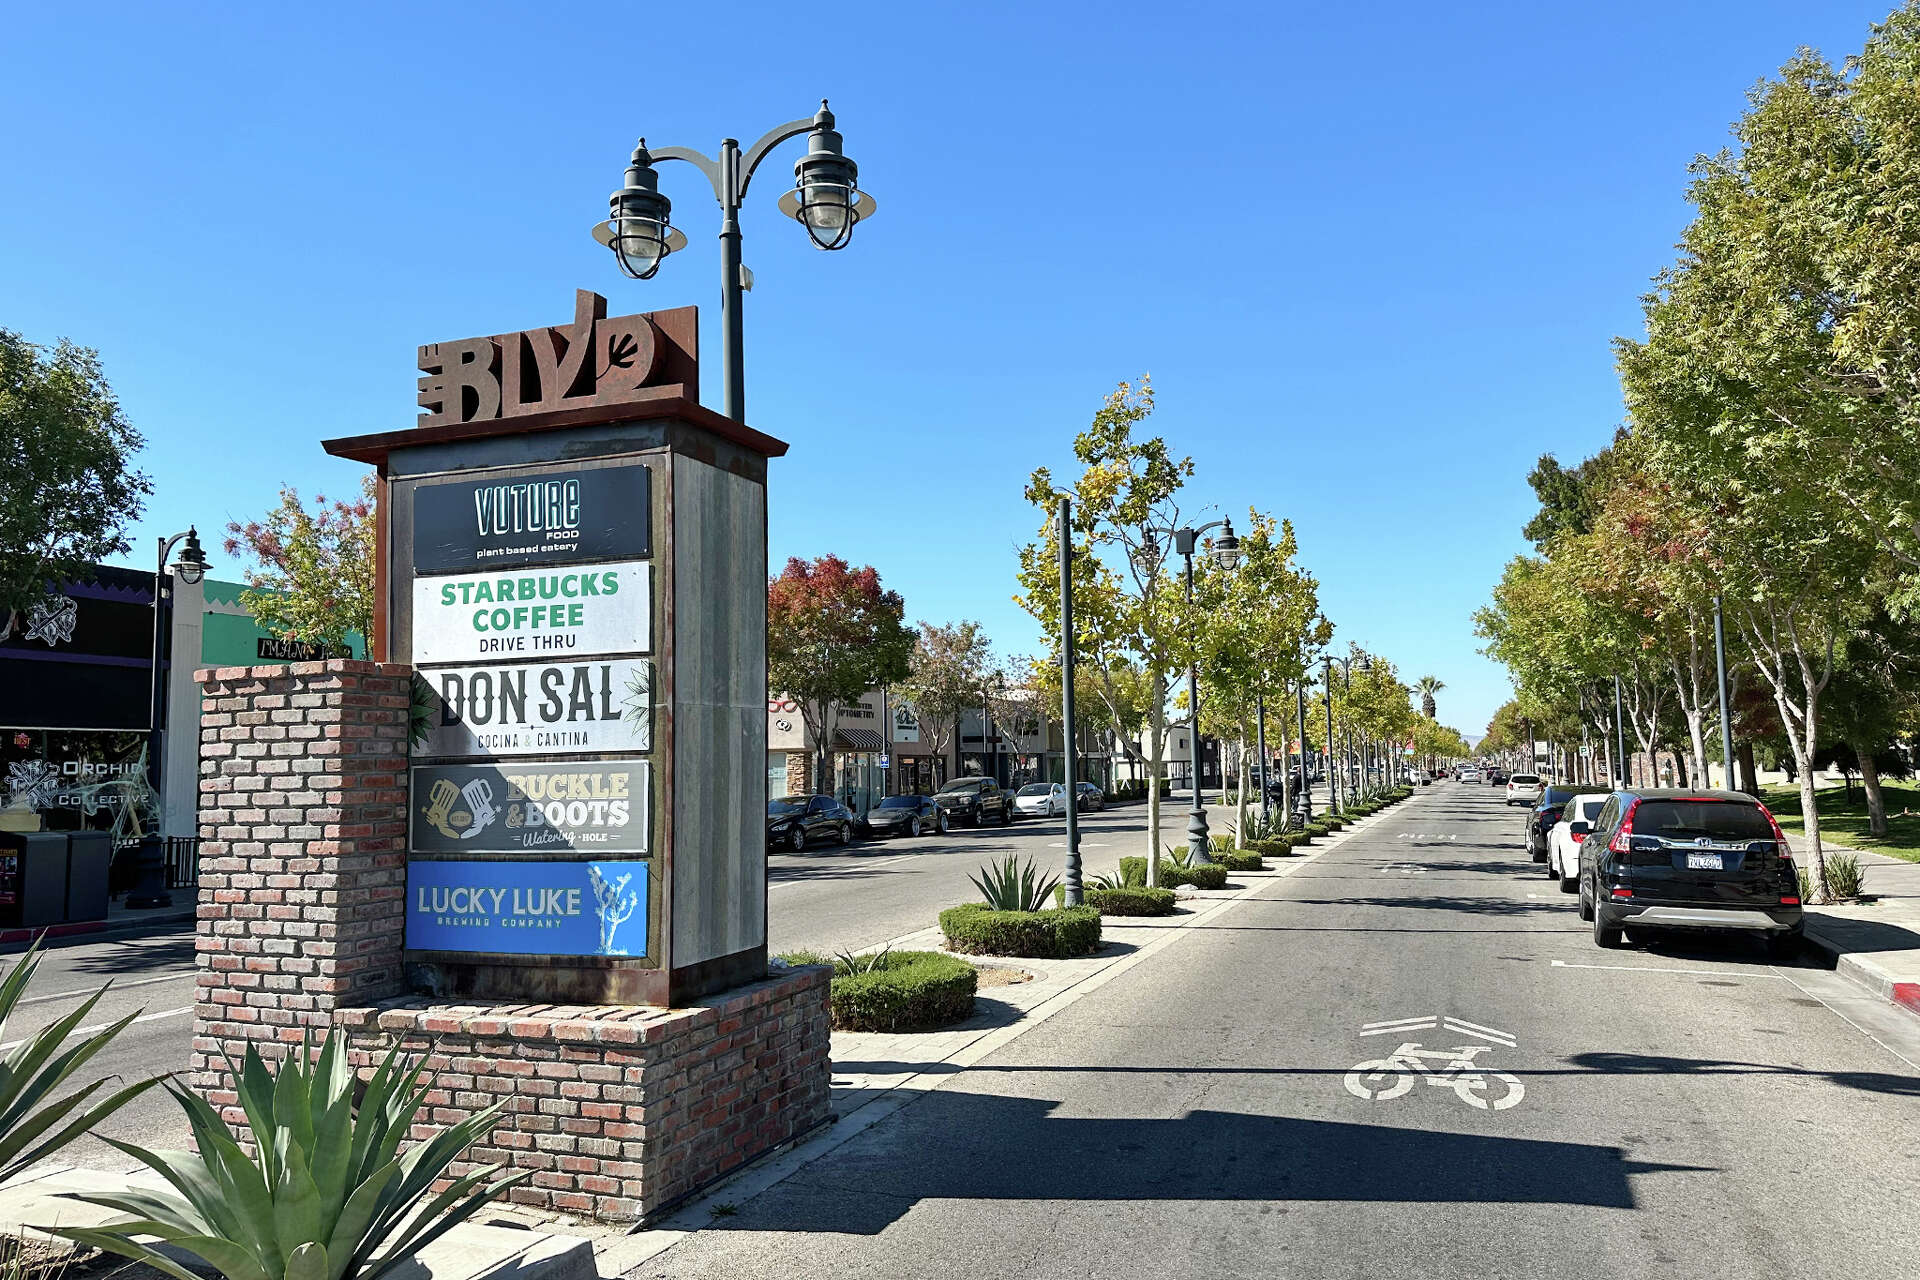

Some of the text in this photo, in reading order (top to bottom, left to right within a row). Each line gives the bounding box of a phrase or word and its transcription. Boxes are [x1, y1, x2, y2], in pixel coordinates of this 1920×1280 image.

[546, 530, 579, 540] FOOD
[476, 541, 578, 559] plant based eatery
[441, 572, 619, 606] STARBUCKS
[472, 603, 584, 632] COFFEE
[479, 634, 576, 652] DRIVE THRU
[440, 665, 622, 727] DON SAL
[478, 731, 588, 749] COCINA & CANTINA
[506, 773, 630, 801] BUCKLE
[522, 829, 608, 847] Watering HOLE
[417, 886, 582, 915] LUCKY LUKE
[437, 916, 562, 929] BREWING COMPANY
